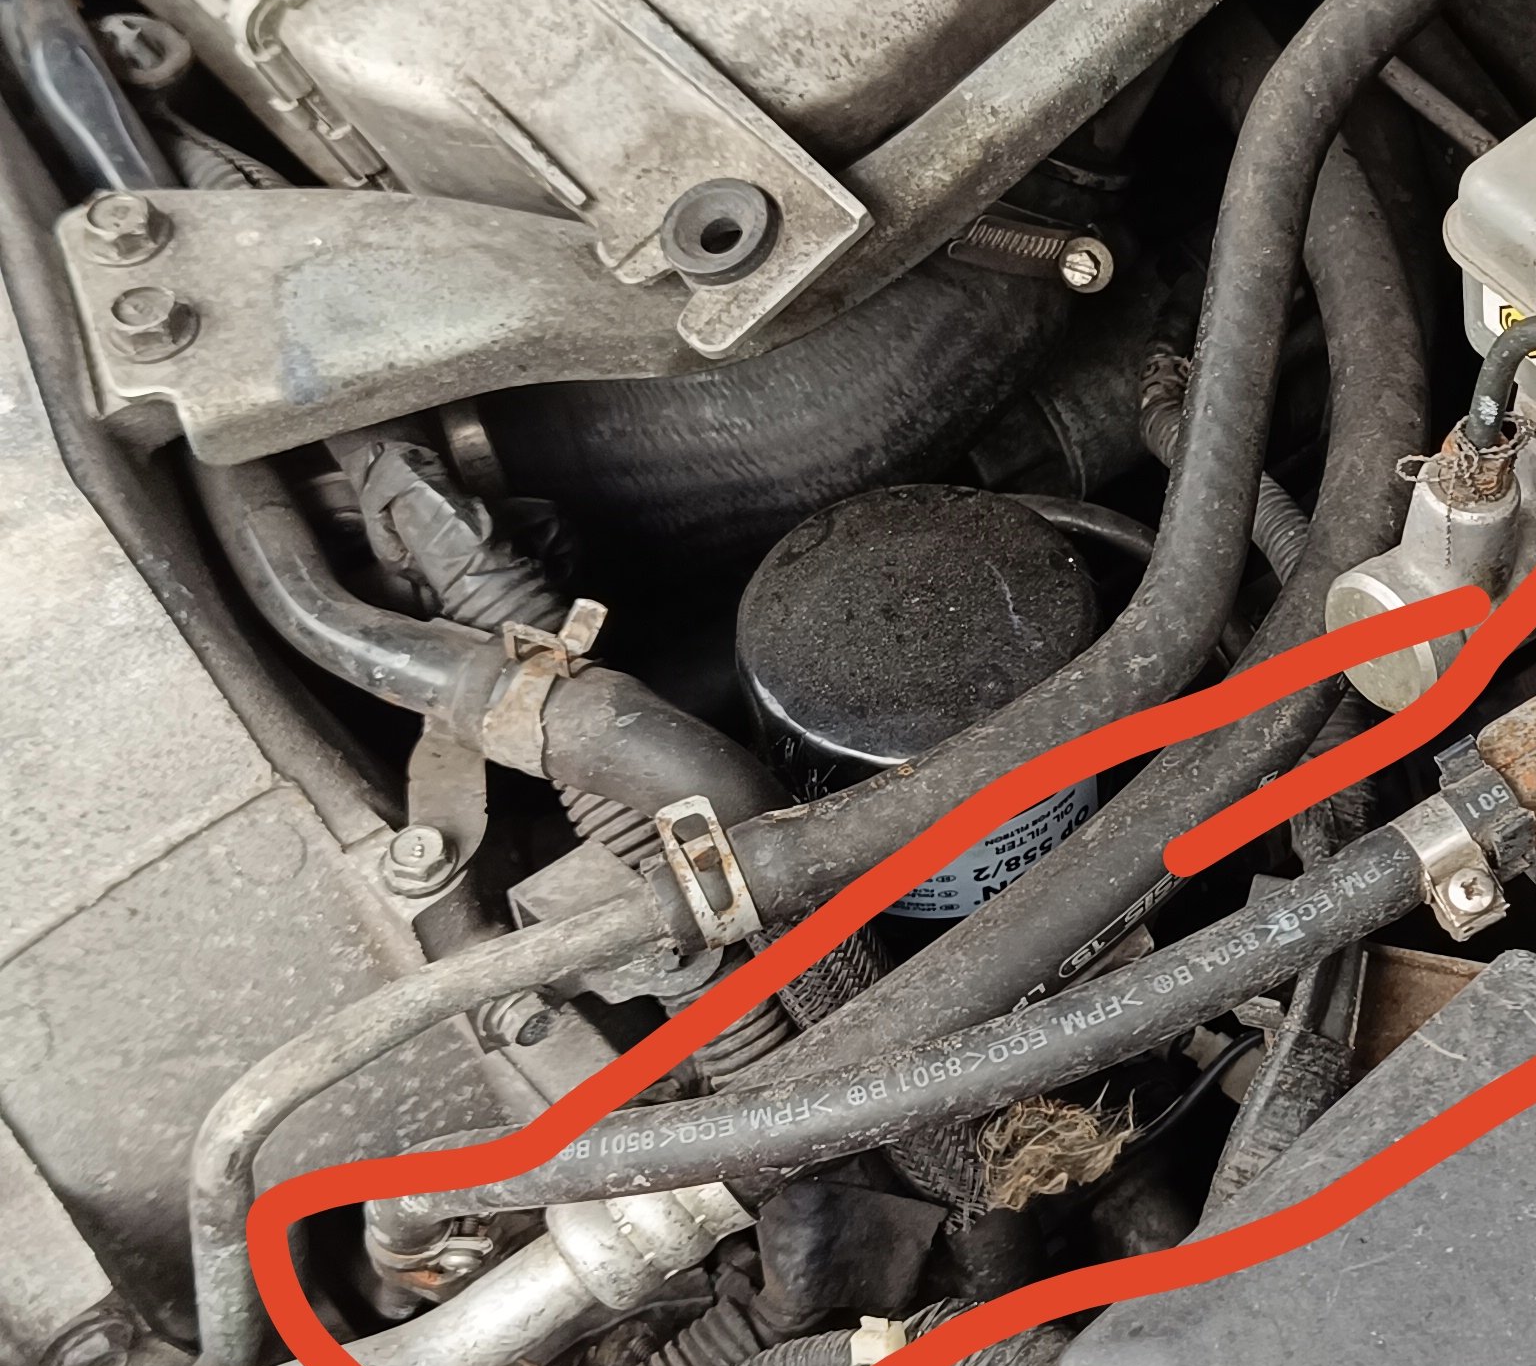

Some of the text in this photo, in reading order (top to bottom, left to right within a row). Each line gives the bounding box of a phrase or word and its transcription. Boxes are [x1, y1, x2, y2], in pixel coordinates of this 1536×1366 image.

[970, 804, 1091, 883] OP 558/2
[983, 822, 1029, 847] FILTRON
[993, 801, 1075, 855] OIL FILTER
[1030, 810, 1051, 826] FOR
[1071, 874, 1180, 971] SIS 15
